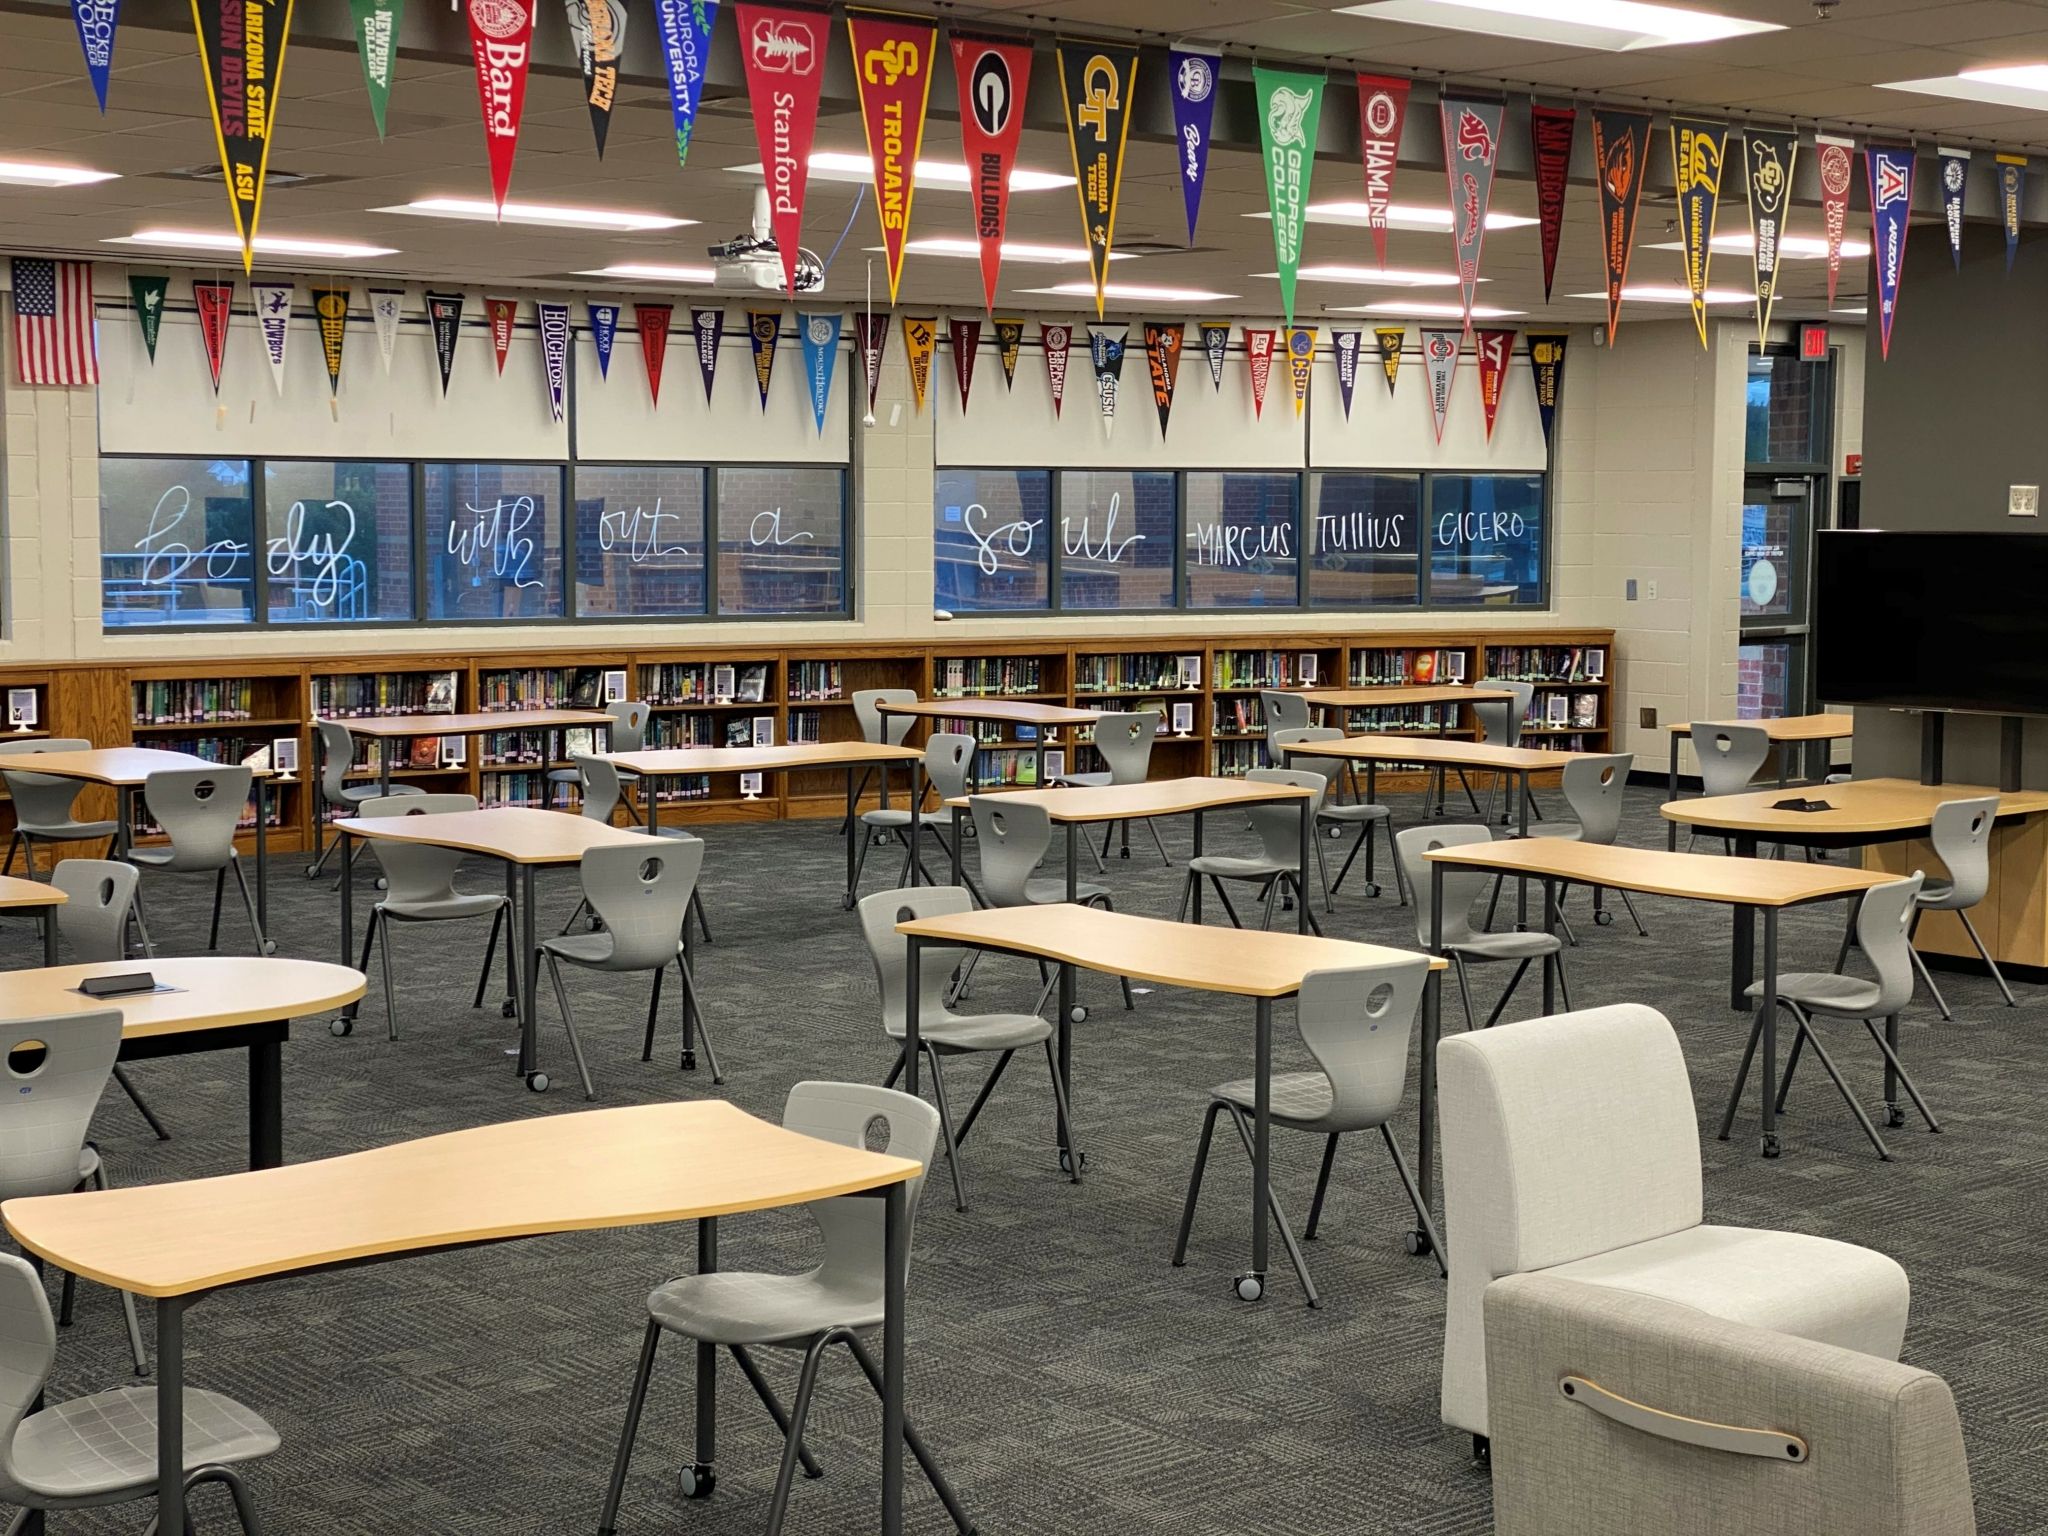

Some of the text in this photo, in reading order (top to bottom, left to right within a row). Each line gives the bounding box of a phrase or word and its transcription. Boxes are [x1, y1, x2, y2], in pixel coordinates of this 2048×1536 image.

[77, 0, 98, 66] OLLEGE
[363, 17, 379, 80] COLLEGE
[373, 10, 392, 88] NEWBURY
[661, 0, 692, 115] UNIVERSITY
[675, 0, 699, 83] AURORA
[220, 0, 246, 138] SUN DEVILS
[246, 1, 266, 139] ARIZONA STATE
[477, 52, 488, 82] PLACE
[486, 39, 527, 138] Bard
[588, 66, 616, 112] TECH
[774, 91, 798, 215] Stanford
[883, 100, 903, 231] TROJANS
[1182, 123, 1200, 183] Bears
[1538, 121, 1573, 152] SAN
[1680, 129, 1690, 193] BEARS
[1694, 131, 1719, 195] Cal
[236, 163, 255, 201] ASU
[980, 152, 1000, 239] BULLDOGS
[1087, 163, 1098, 203] TECH
[1097, 152, 1108, 214] GEORGIA
[1271, 146, 1288, 264] COLLEGE
[1286, 149, 1302, 264] GEORGIA
[1365, 139, 1396, 231] HAMLINE
[1539, 153, 1567, 202] DIEGO
[1692, 196, 1700, 249] CALIFORNIA
[1758, 218, 1767, 272] BUFFALOES
[1766, 218, 1775, 272] COLORADO
[1887, 216, 1898, 287] ARIZONA
[262, 318, 286, 364] COWBOYS
[321, 319, 344, 376] HOLLINS
[496, 319, 507, 350] IUPUI
[544, 310, 566, 388] HOUGHTON
[700, 329, 708, 364] COLLEGE
[1805, 328, 1826, 357] EXIT
[1101, 372, 1115, 417] CSUSM
[1145, 327, 1170, 408] STATE
[1160, 347, 1172, 391] OKLAHOMA
[1291, 358, 1310, 399] CSUB
[1438, 512, 1525, 547] CICERO
